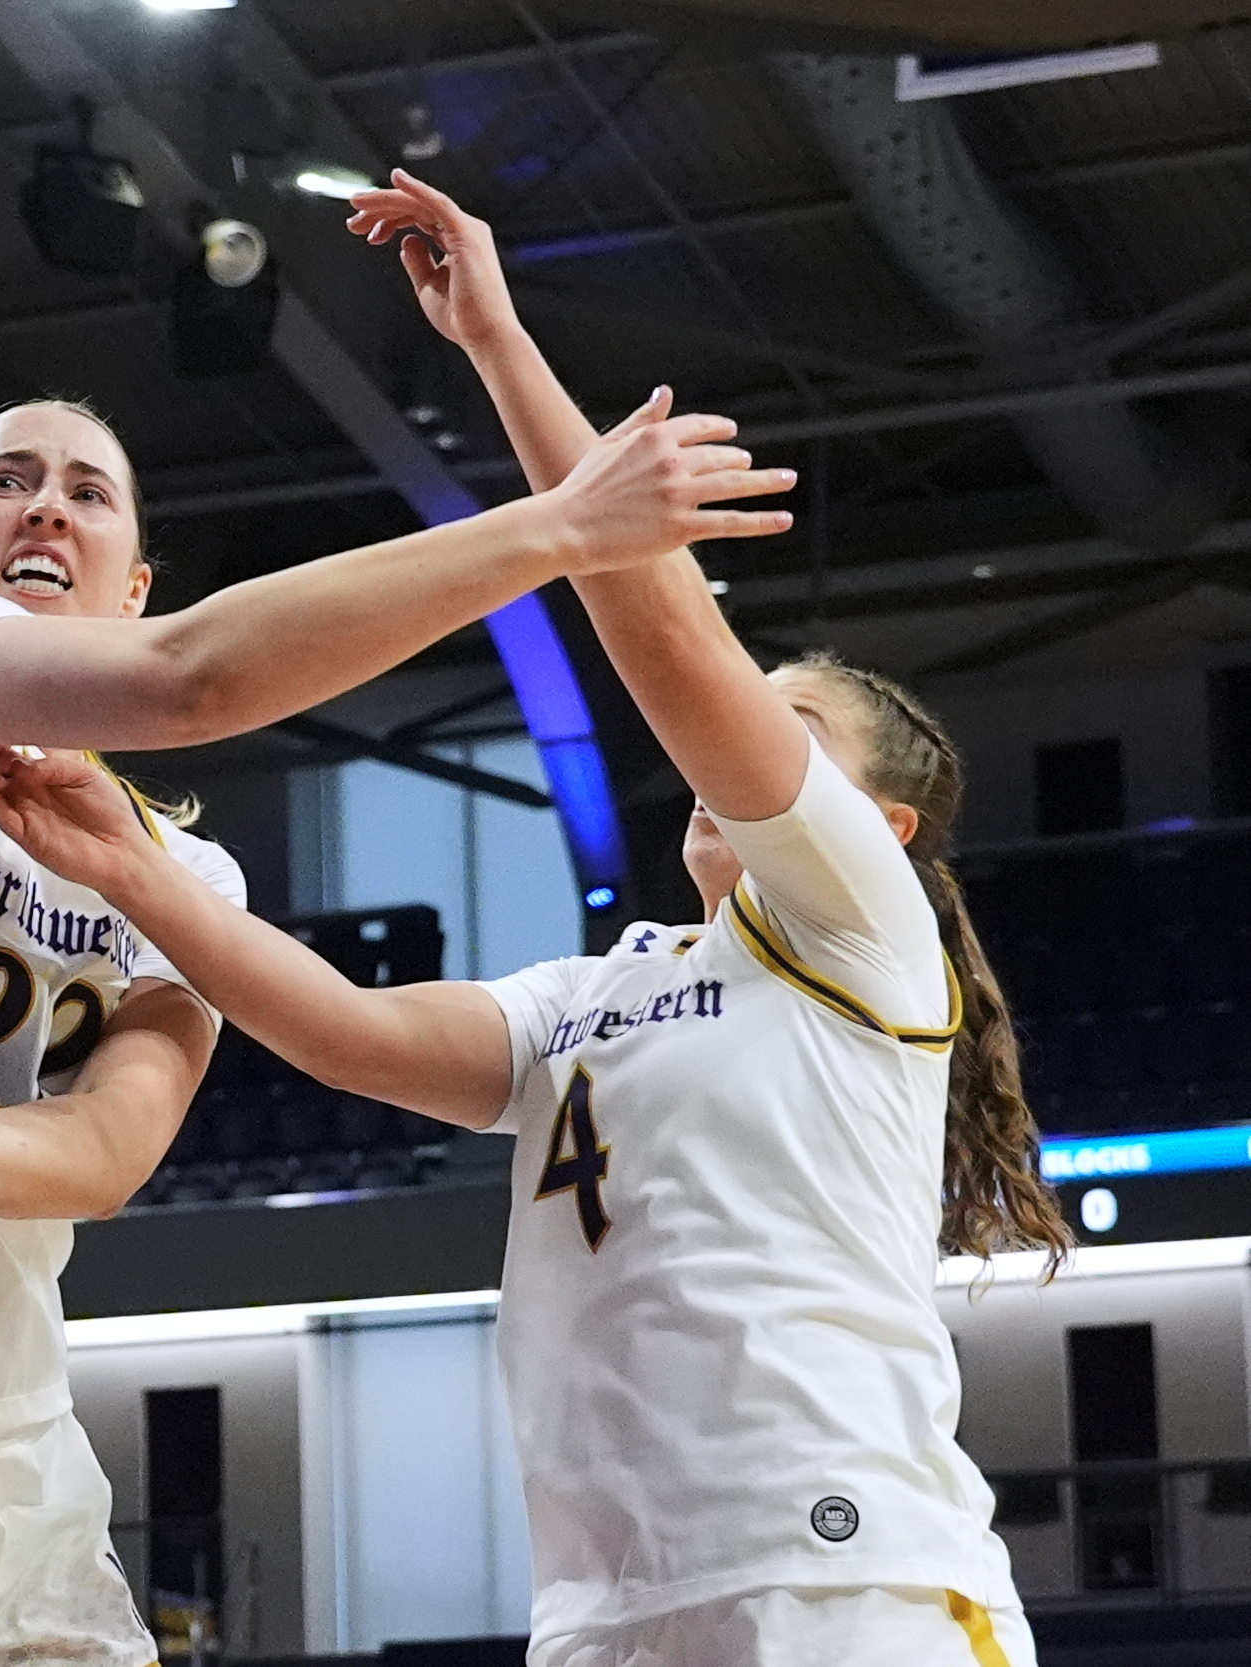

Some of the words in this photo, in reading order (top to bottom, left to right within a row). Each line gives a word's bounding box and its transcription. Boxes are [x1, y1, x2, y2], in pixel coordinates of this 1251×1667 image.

[543, 979, 726, 1059] hwestern
[533, 1062, 613, 1255] 4
[1081, 1188, 1118, 1232] 0
